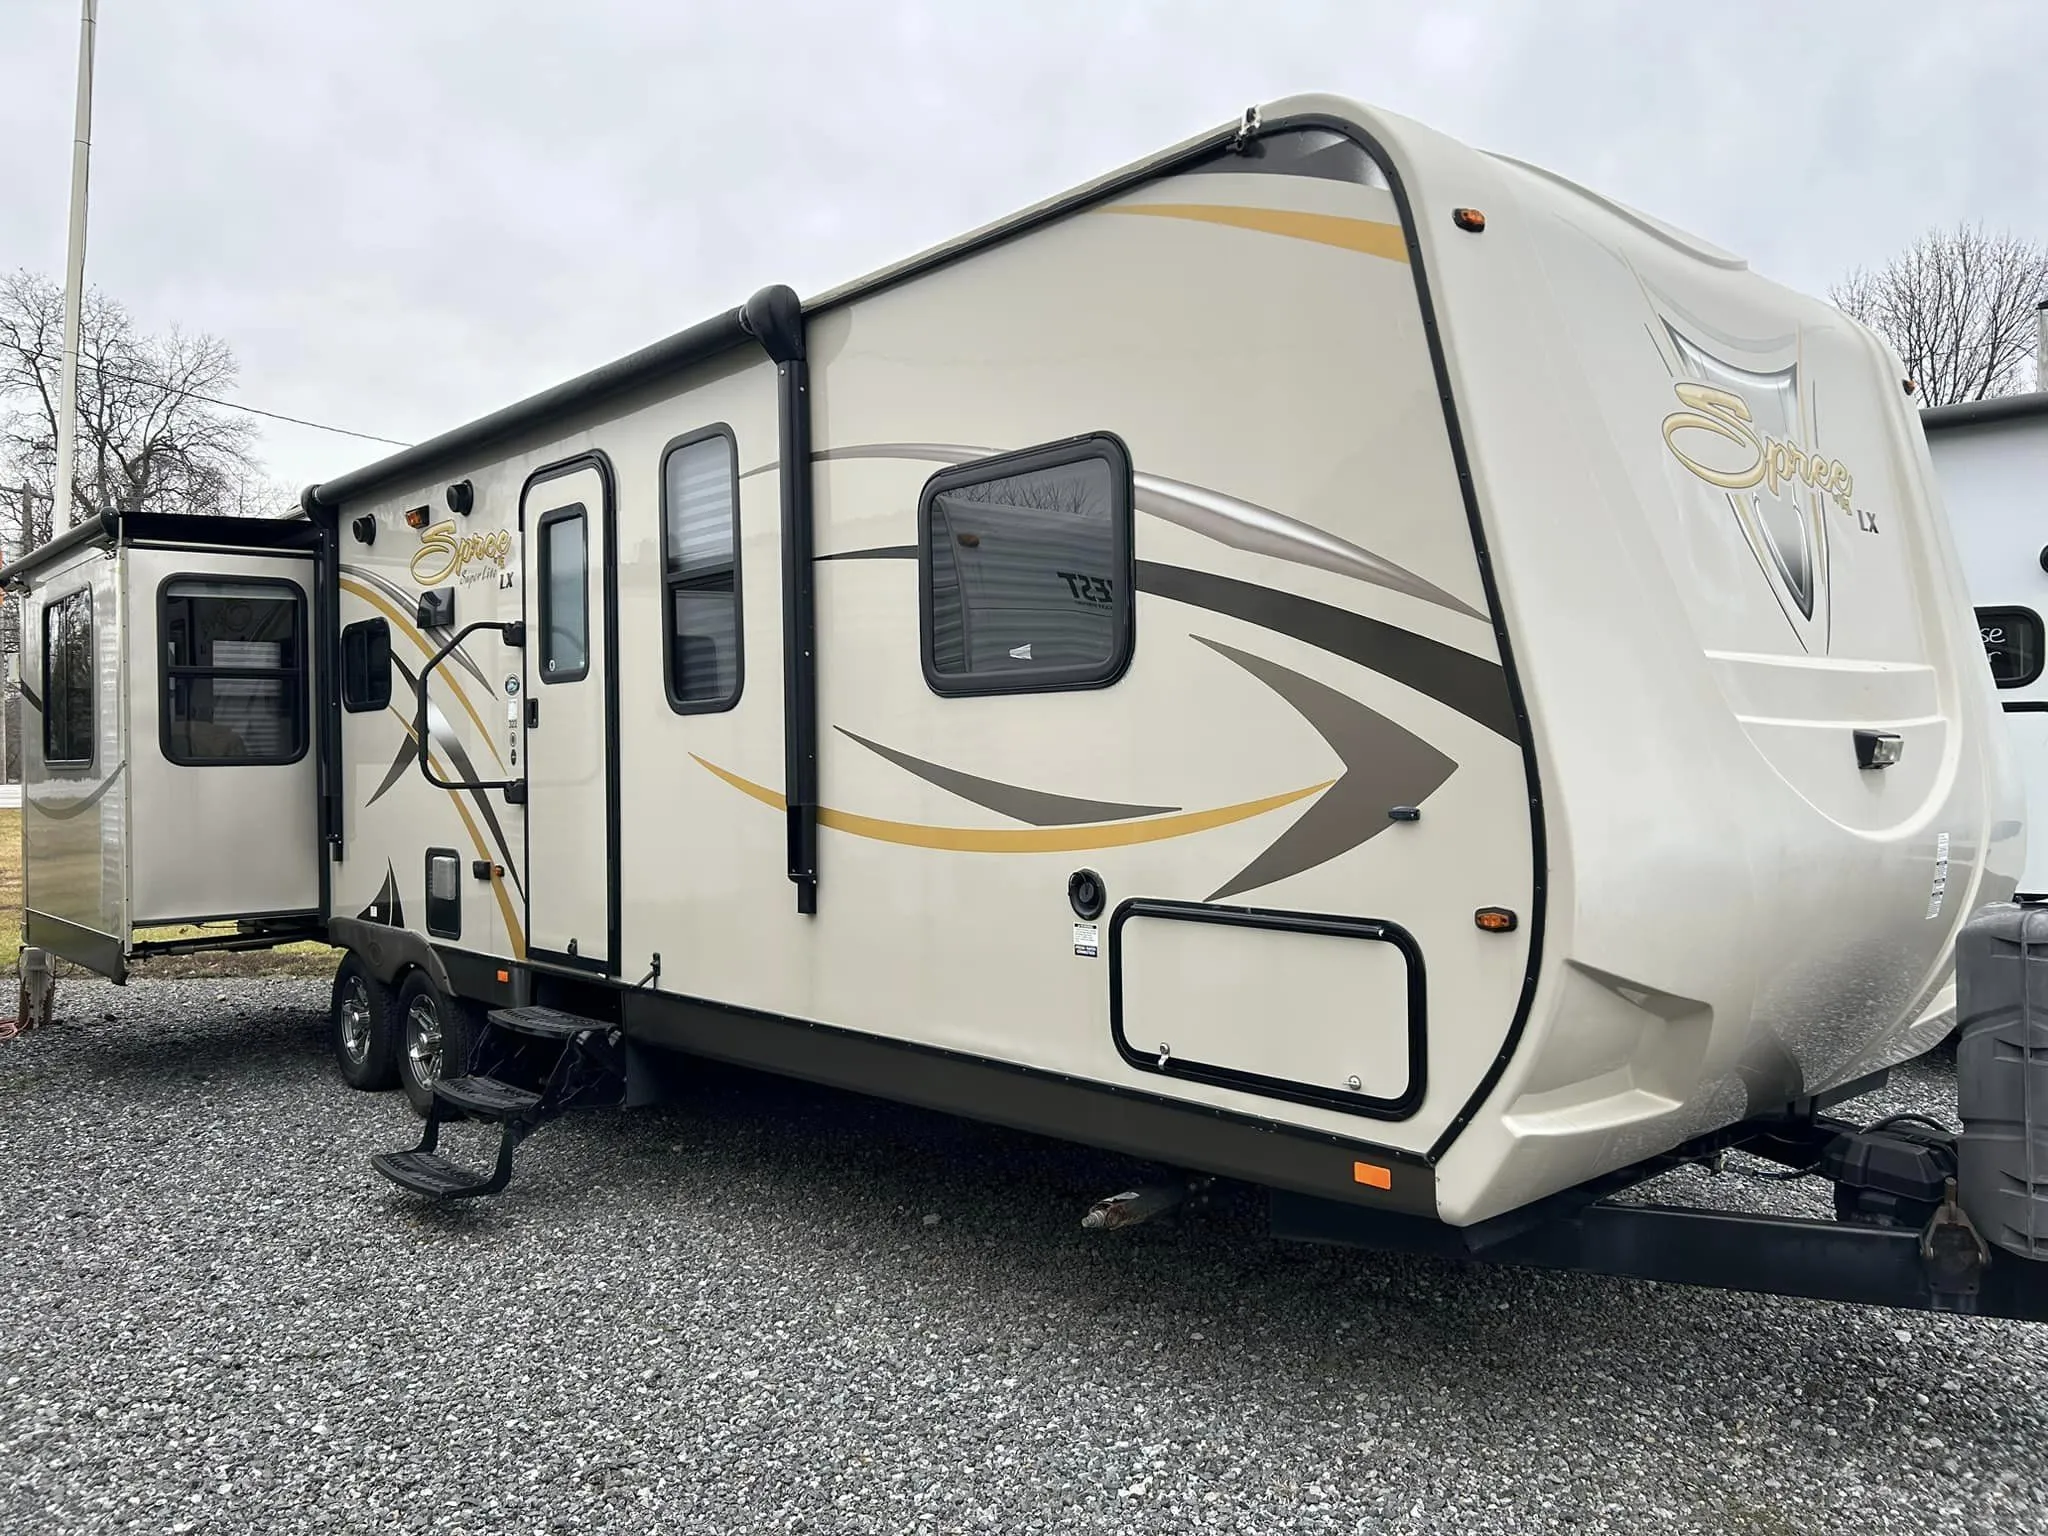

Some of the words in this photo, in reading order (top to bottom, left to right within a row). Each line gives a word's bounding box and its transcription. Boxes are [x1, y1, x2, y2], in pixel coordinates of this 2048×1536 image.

[1661, 382, 1853, 497] Spree
[1856, 509, 1879, 534] LX
[410, 518, 512, 586] Spree
[500, 571, 514, 590] LX
